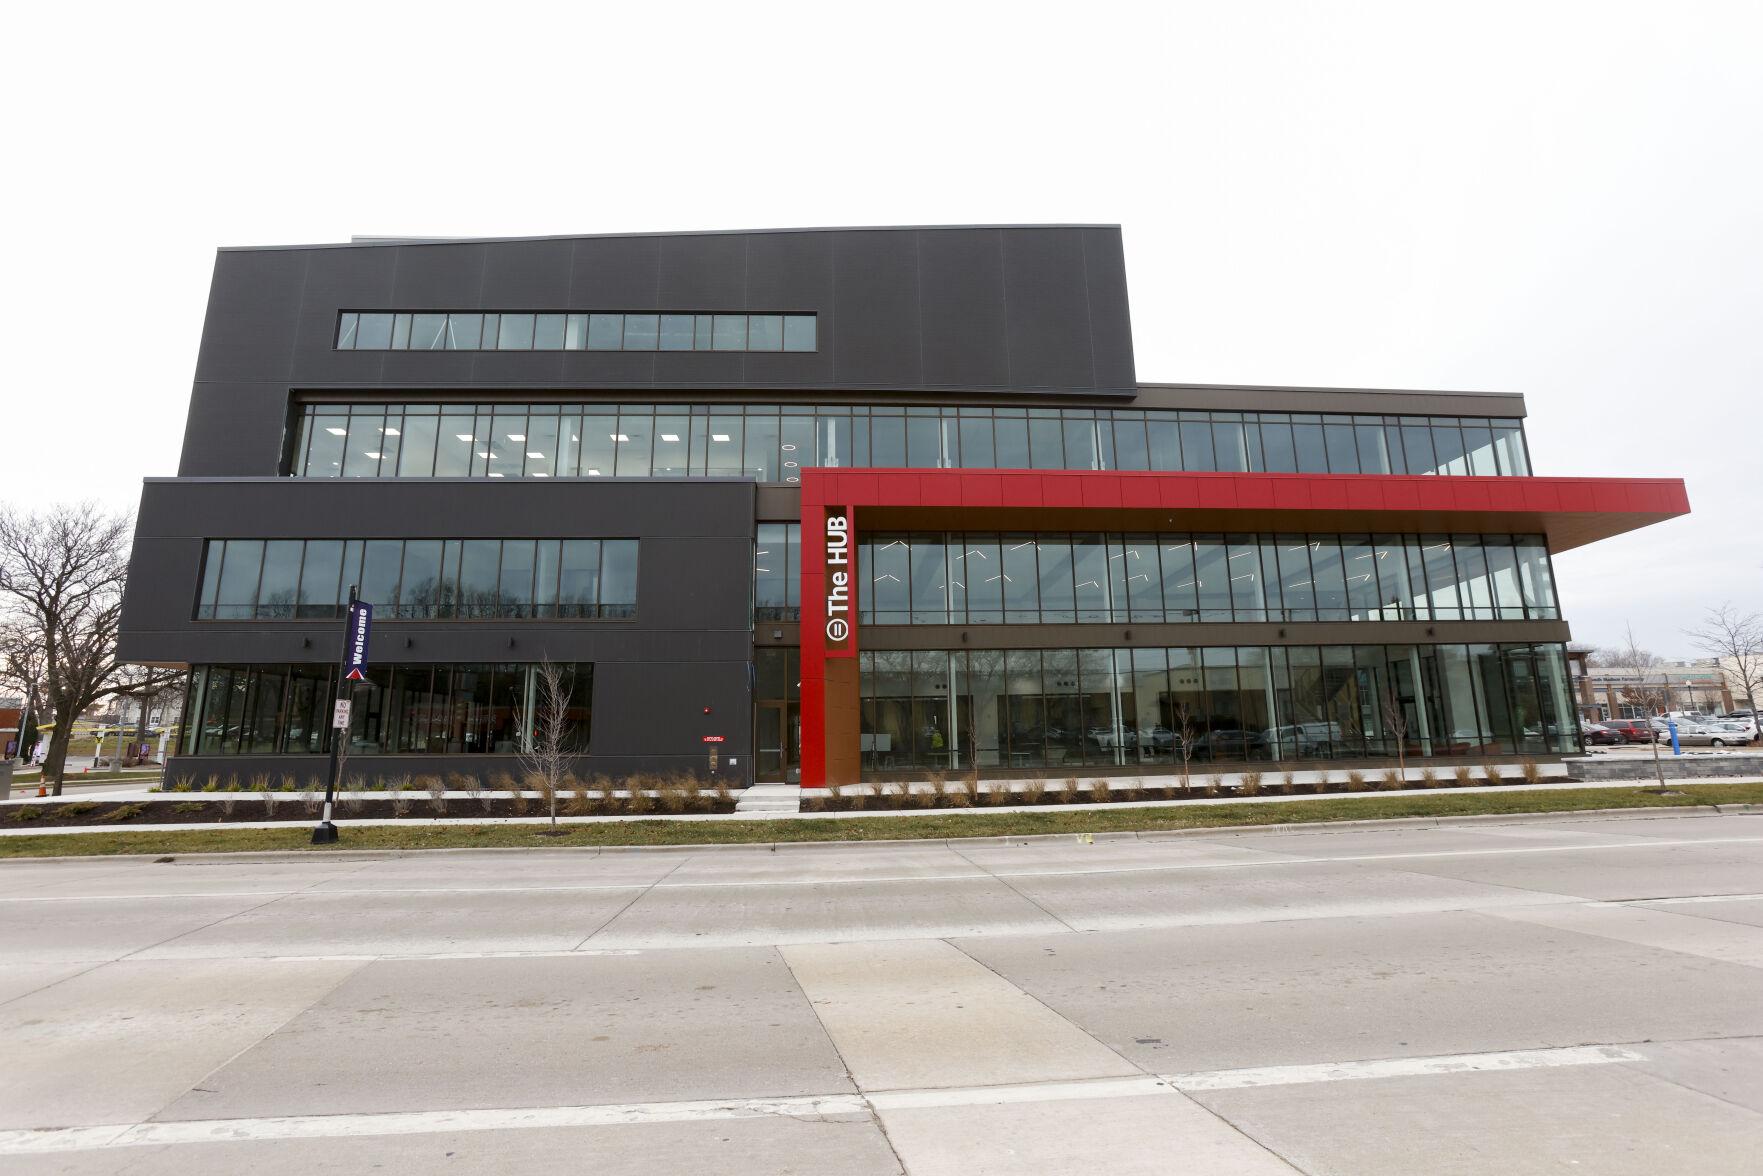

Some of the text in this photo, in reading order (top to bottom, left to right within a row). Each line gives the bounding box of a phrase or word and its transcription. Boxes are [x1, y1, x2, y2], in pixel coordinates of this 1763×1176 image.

[827, 516, 848, 616] The HUB
[353, 608, 367, 665] Welcome
